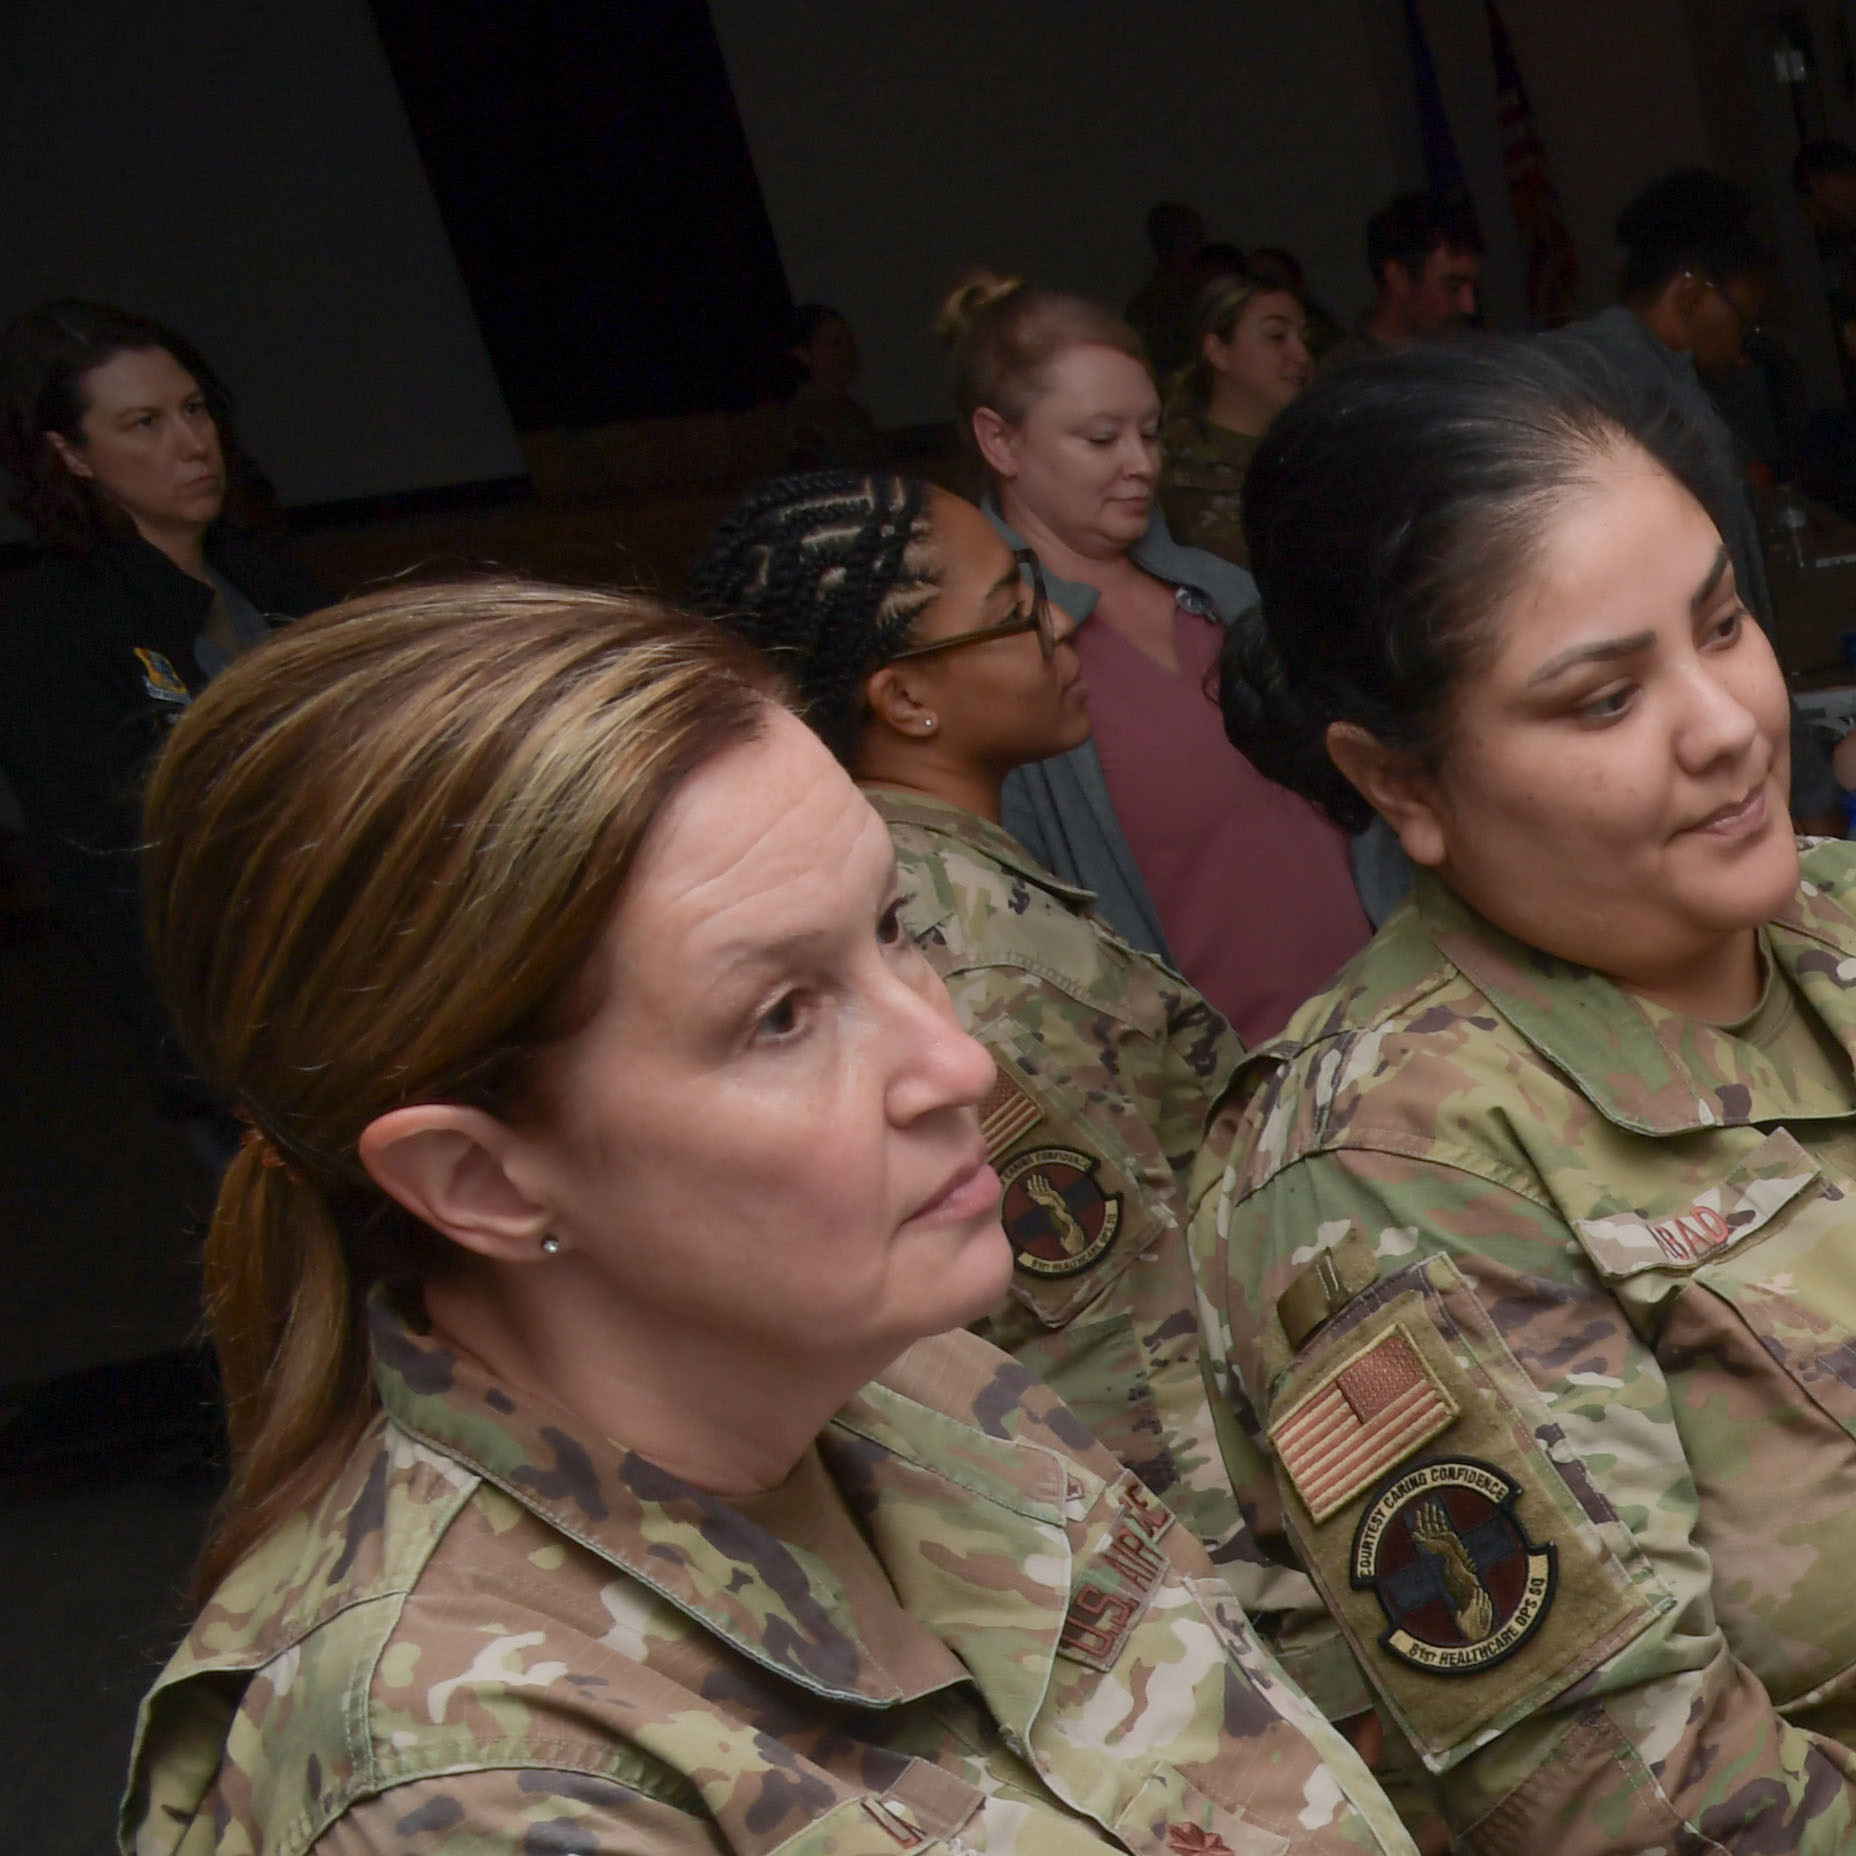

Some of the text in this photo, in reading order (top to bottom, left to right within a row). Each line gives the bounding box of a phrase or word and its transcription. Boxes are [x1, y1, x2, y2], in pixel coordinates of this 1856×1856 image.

[1103, 1525, 1165, 1593] AIR
[1359, 1467, 1507, 1578] COURTESY CARING CONFIDENCE
[1439, 1623, 1519, 1666] HEALTHCARE
[1517, 1600, 1538, 1627] OPS
[1531, 1576, 1546, 1597] SQ
